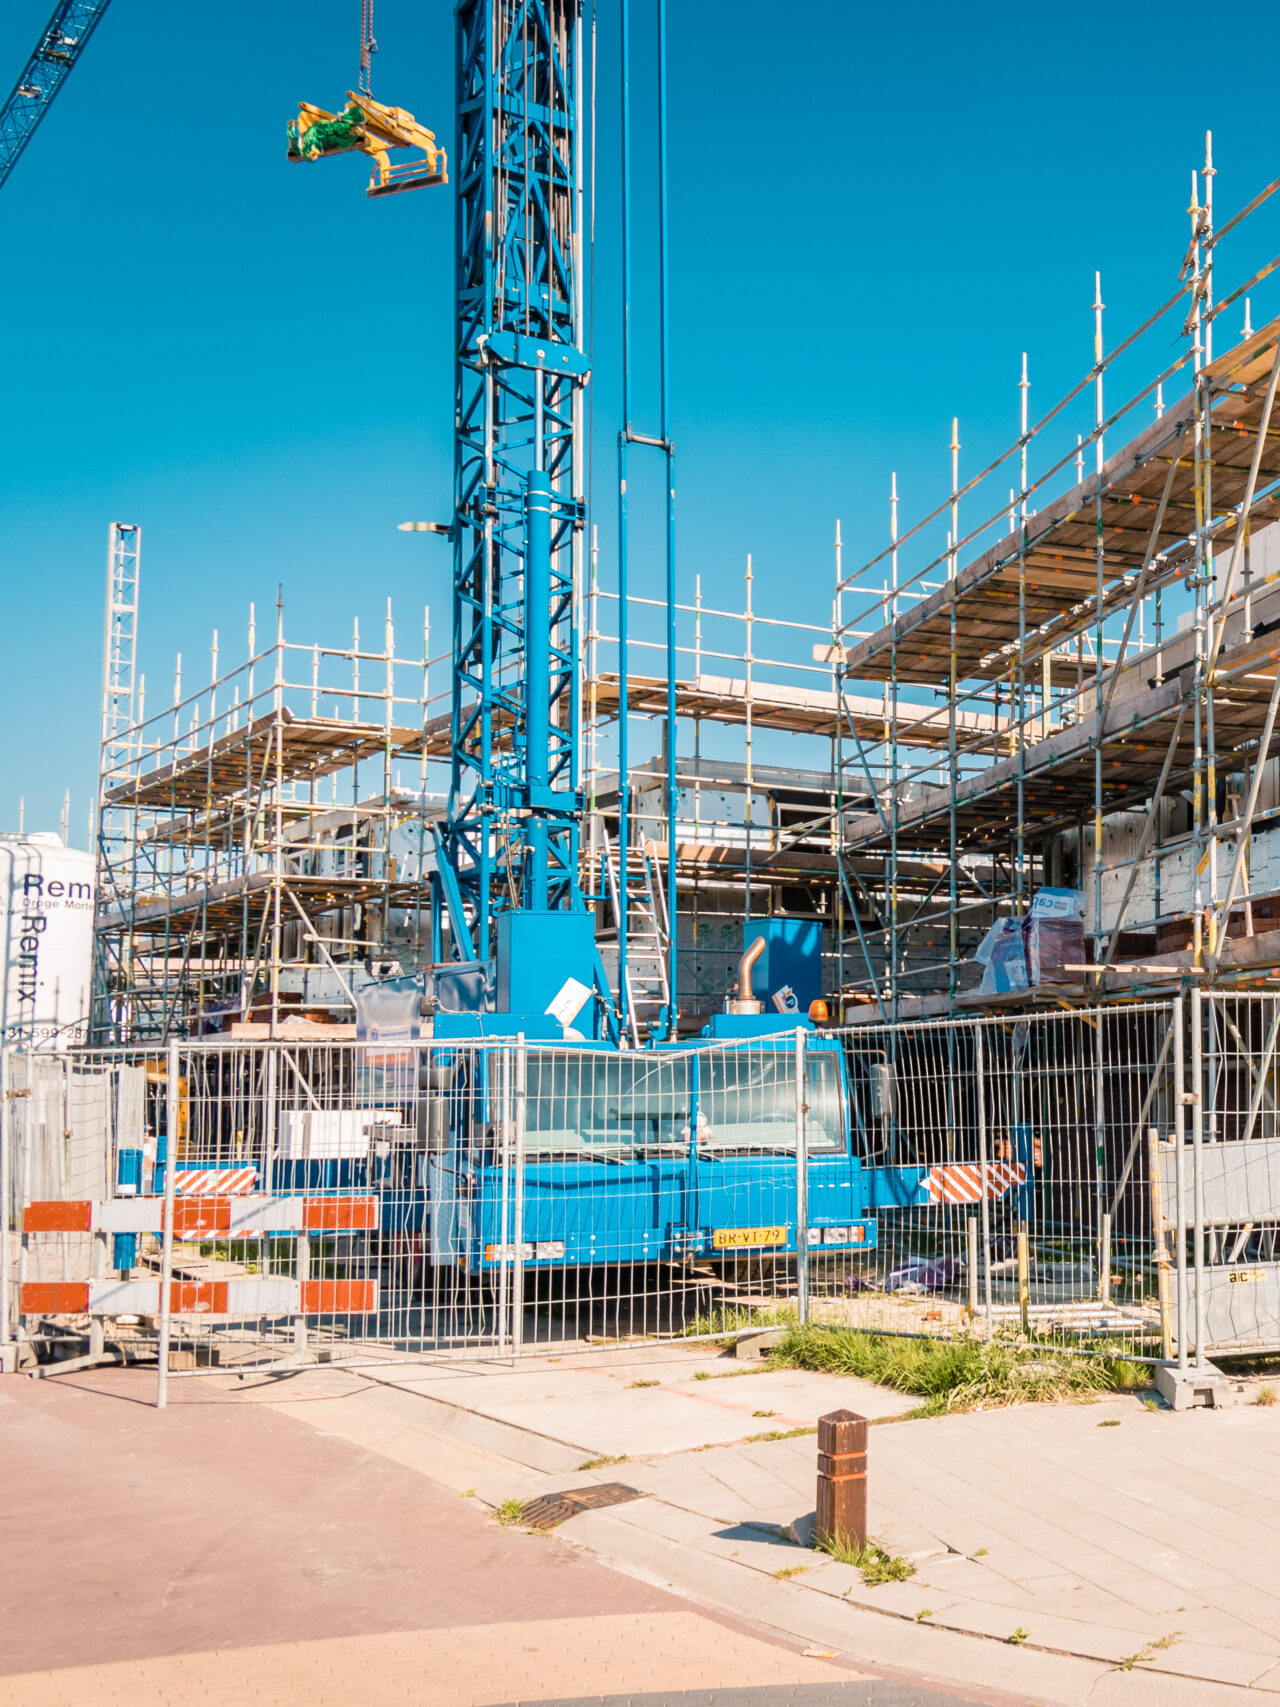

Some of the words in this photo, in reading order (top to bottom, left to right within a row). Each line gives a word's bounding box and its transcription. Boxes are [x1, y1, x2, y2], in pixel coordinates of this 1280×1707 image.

[23, 898, 60, 910] Droge
[18, 915, 46, 1003] Remix
[719, 1230, 781, 1244] BR-VT-79
